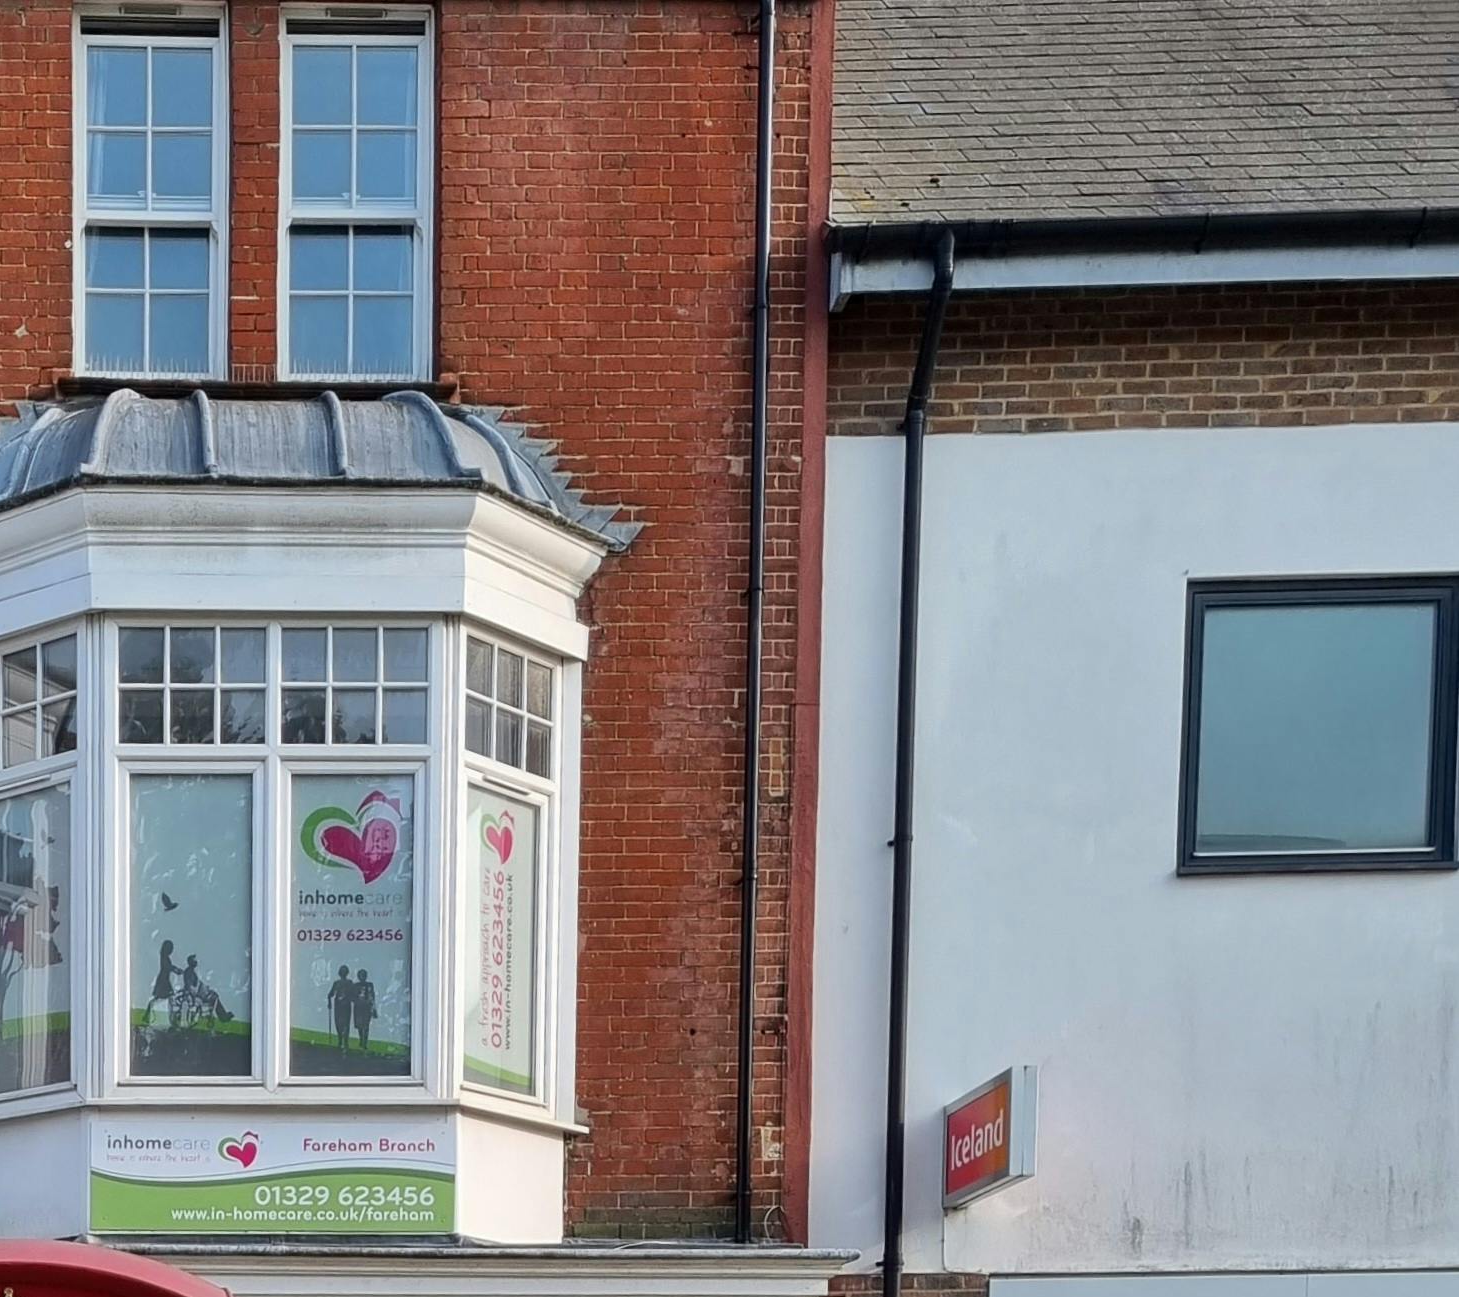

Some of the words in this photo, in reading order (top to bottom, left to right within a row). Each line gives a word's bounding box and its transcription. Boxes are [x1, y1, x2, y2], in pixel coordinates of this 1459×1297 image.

[492, 870, 505, 966] 623456
[297, 929, 341, 941] 01329
[347, 929, 403, 941] 623456
[491, 974, 503, 1049] 01329
[107, 1134, 210, 1150] inhomecare
[303, 1138, 372, 1151] Fareham
[379, 1138, 435, 1151] Branch
[951, 1108, 1004, 1171] Iceland
[255, 1186, 330, 1206] 01329
[339, 1187, 434, 1206] 623456
[171, 1207, 434, 1222] www.in-homecare.co.uk/fareham
